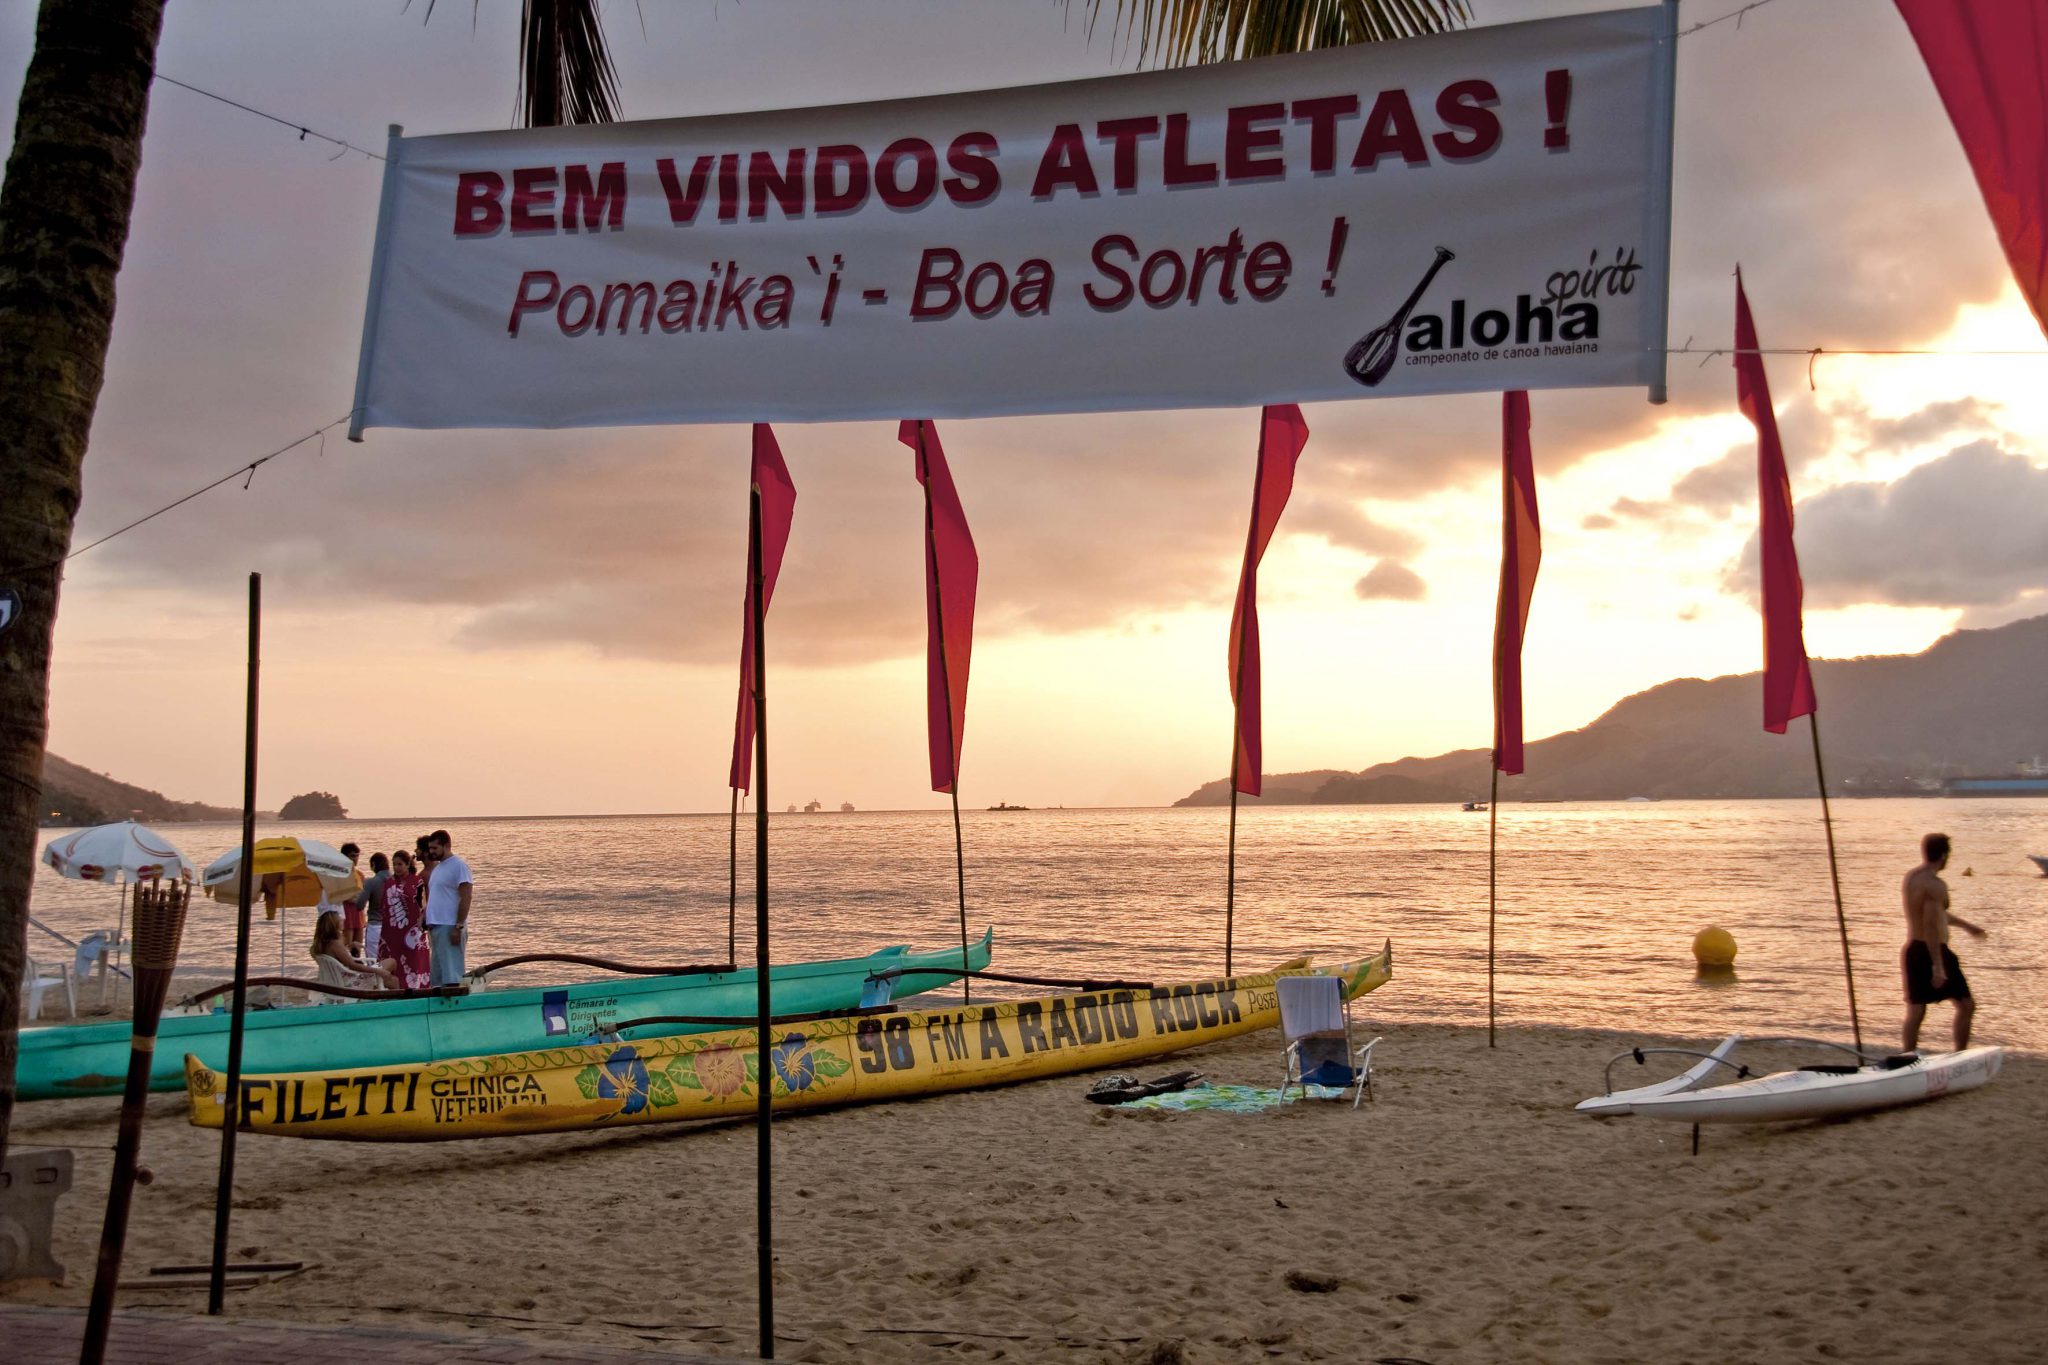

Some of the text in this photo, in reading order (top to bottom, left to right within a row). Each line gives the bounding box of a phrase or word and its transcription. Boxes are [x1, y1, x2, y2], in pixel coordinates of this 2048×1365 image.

[453, 161, 627, 237] BEM
[655, 131, 1002, 223] VINDOS
[1030, 79, 1502, 198] ATLETAS
[909, 247, 1054, 321] Boa
[1083, 226, 1292, 309] Sorte
[1540, 246, 1643, 319] spirit
[1405, 294, 1599, 352] aloha
[1405, 342, 1598, 366] campeonato de canoa havaiana
[607, 996, 618, 1006] de
[856, 1016, 915, 1074] 98
[926, 1012, 969, 1063] FM
[979, 1006, 1010, 1061] A
[1016, 991, 1139, 1054] RADIO
[1150, 978, 1242, 1036] ROCK
[239, 1072, 422, 1128] FILETTI
[431, 1073, 543, 1097] CLINICA
